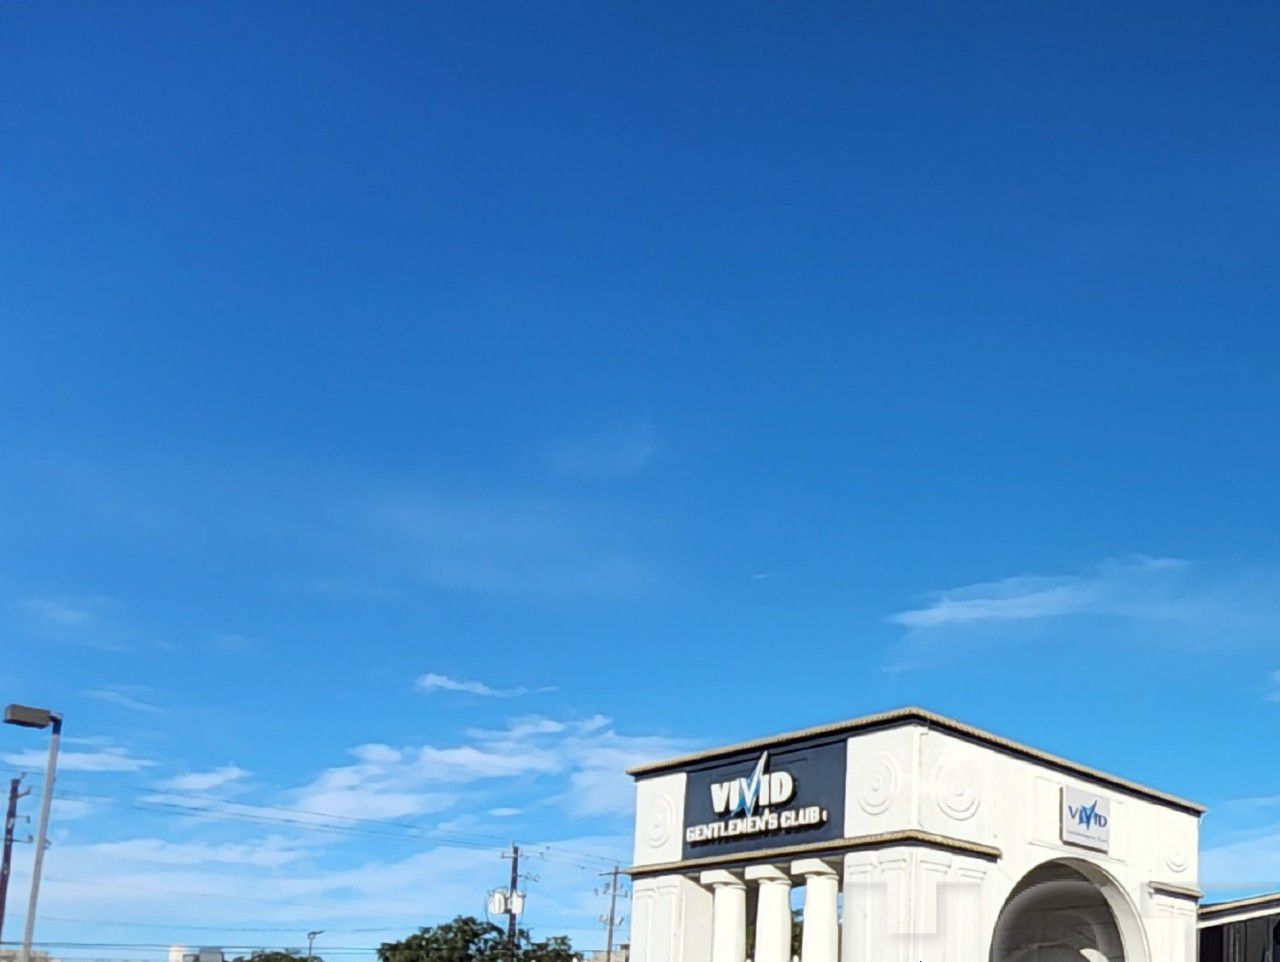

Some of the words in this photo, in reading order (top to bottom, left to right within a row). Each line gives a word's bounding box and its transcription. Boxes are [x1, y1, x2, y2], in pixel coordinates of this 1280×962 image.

[711, 750, 793, 818] VIVID
[780, 806, 820, 828] CLUB
[1068, 800, 1108, 830] VIVID
